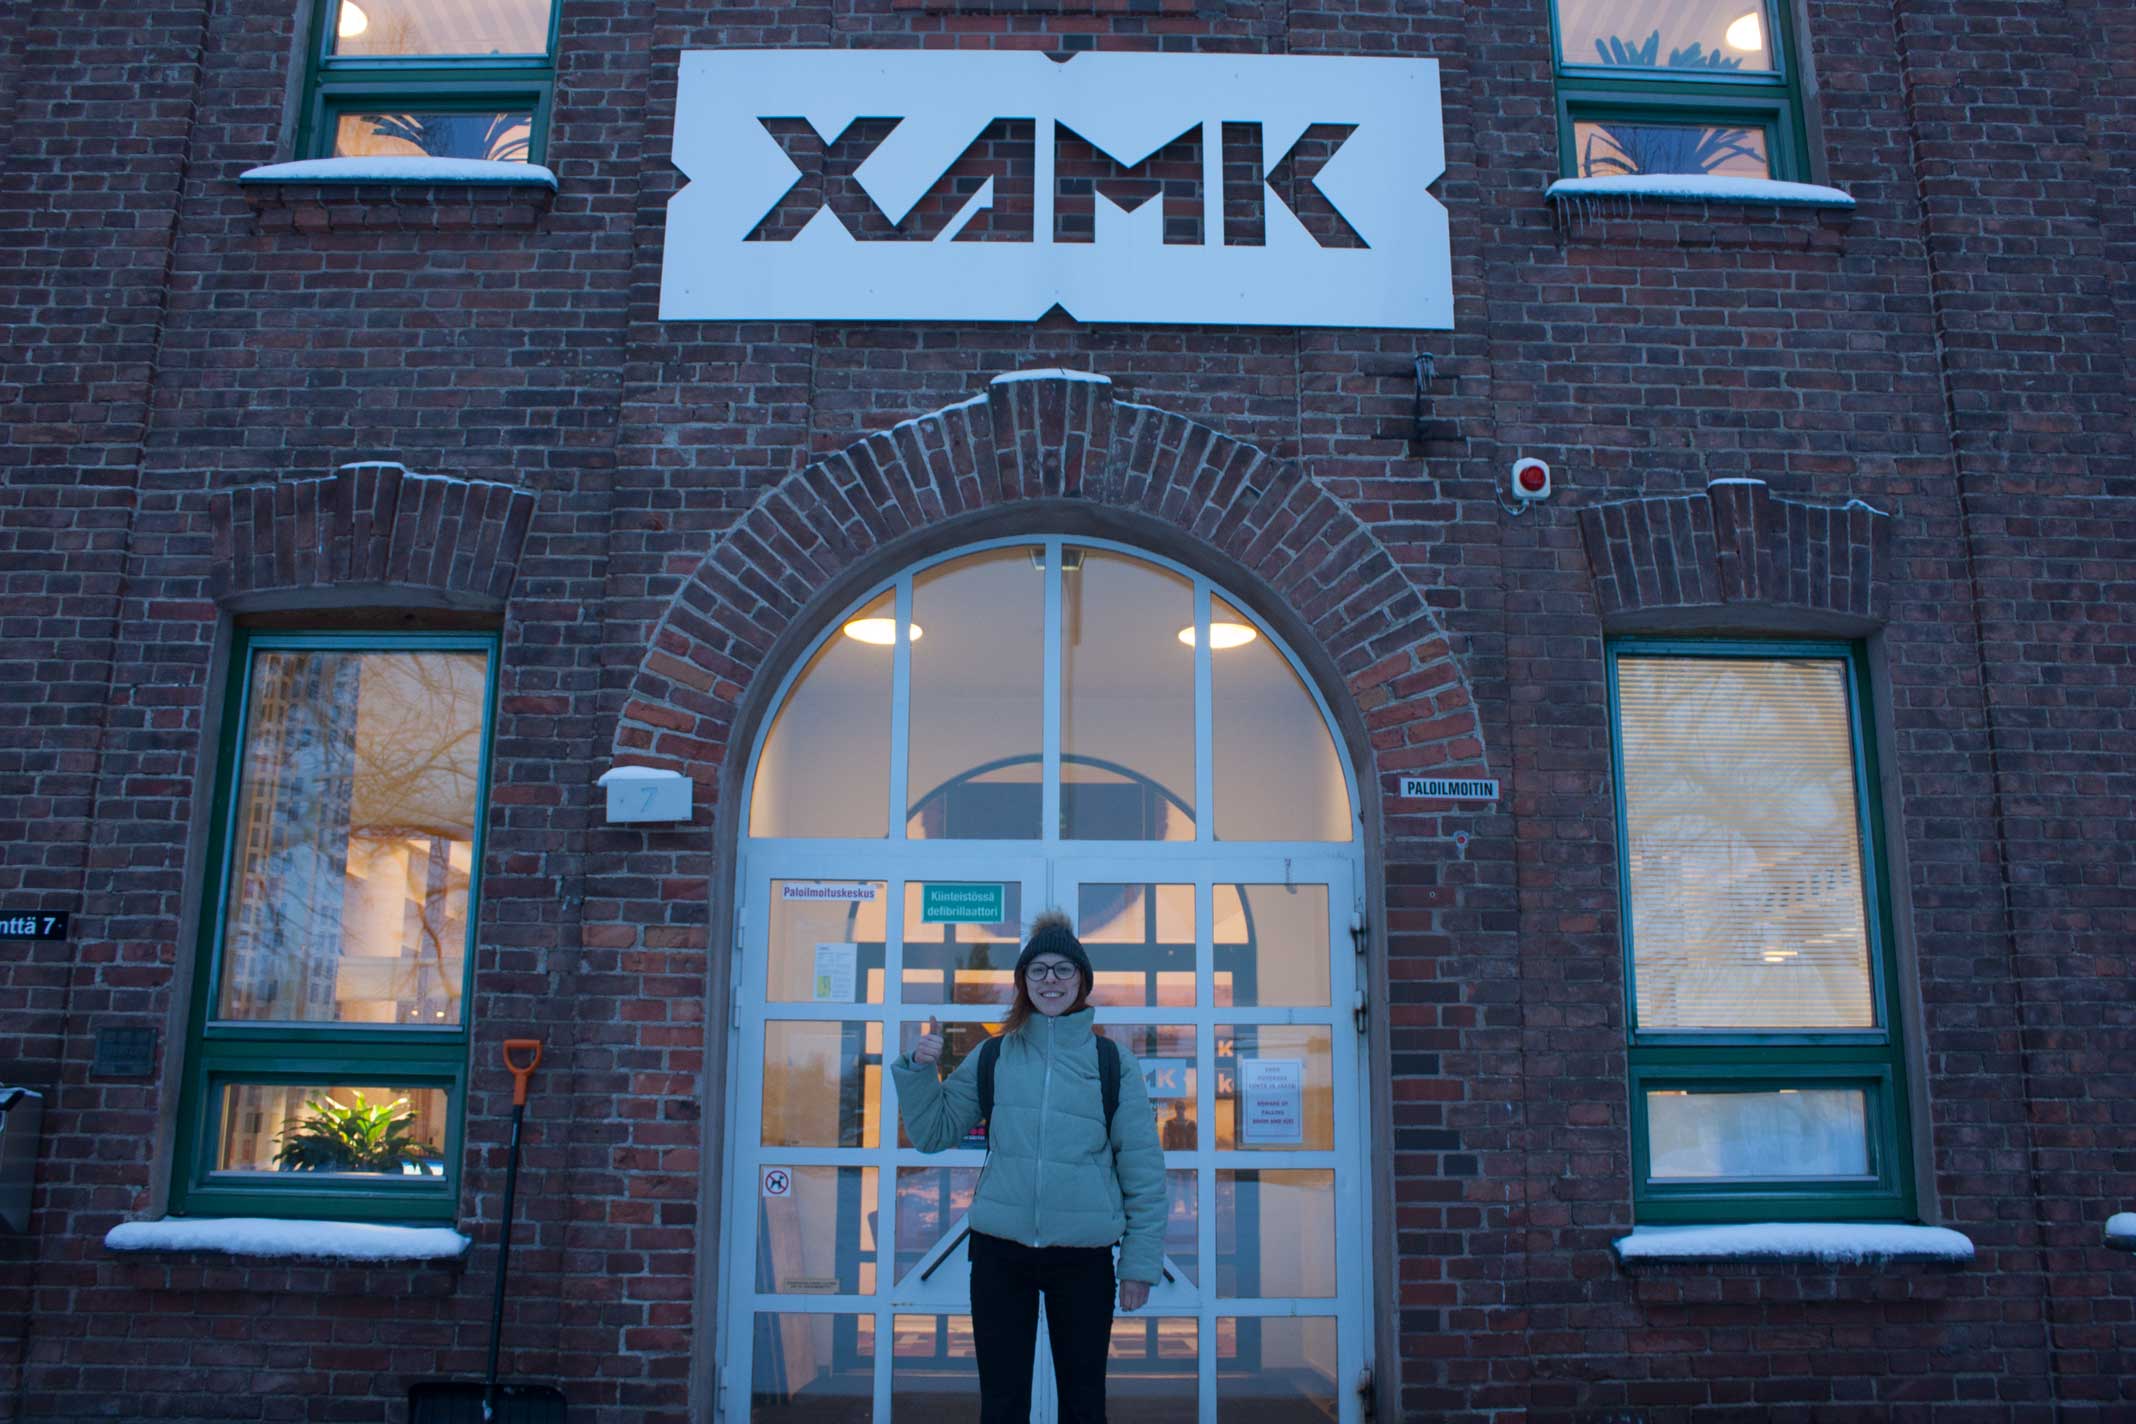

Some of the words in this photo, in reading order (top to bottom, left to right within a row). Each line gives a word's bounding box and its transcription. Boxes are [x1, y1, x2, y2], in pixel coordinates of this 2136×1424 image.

[743, 116, 1372, 249] XAMK
[1408, 781, 1493, 796] PALOILMOITIN
[784, 886, 875, 898] Paloilmoituskeskus
[931, 890, 994, 902] Kiinteistössä
[928, 906, 998, 917] defibrillaattori
[43, 917, 56, 935] 7
